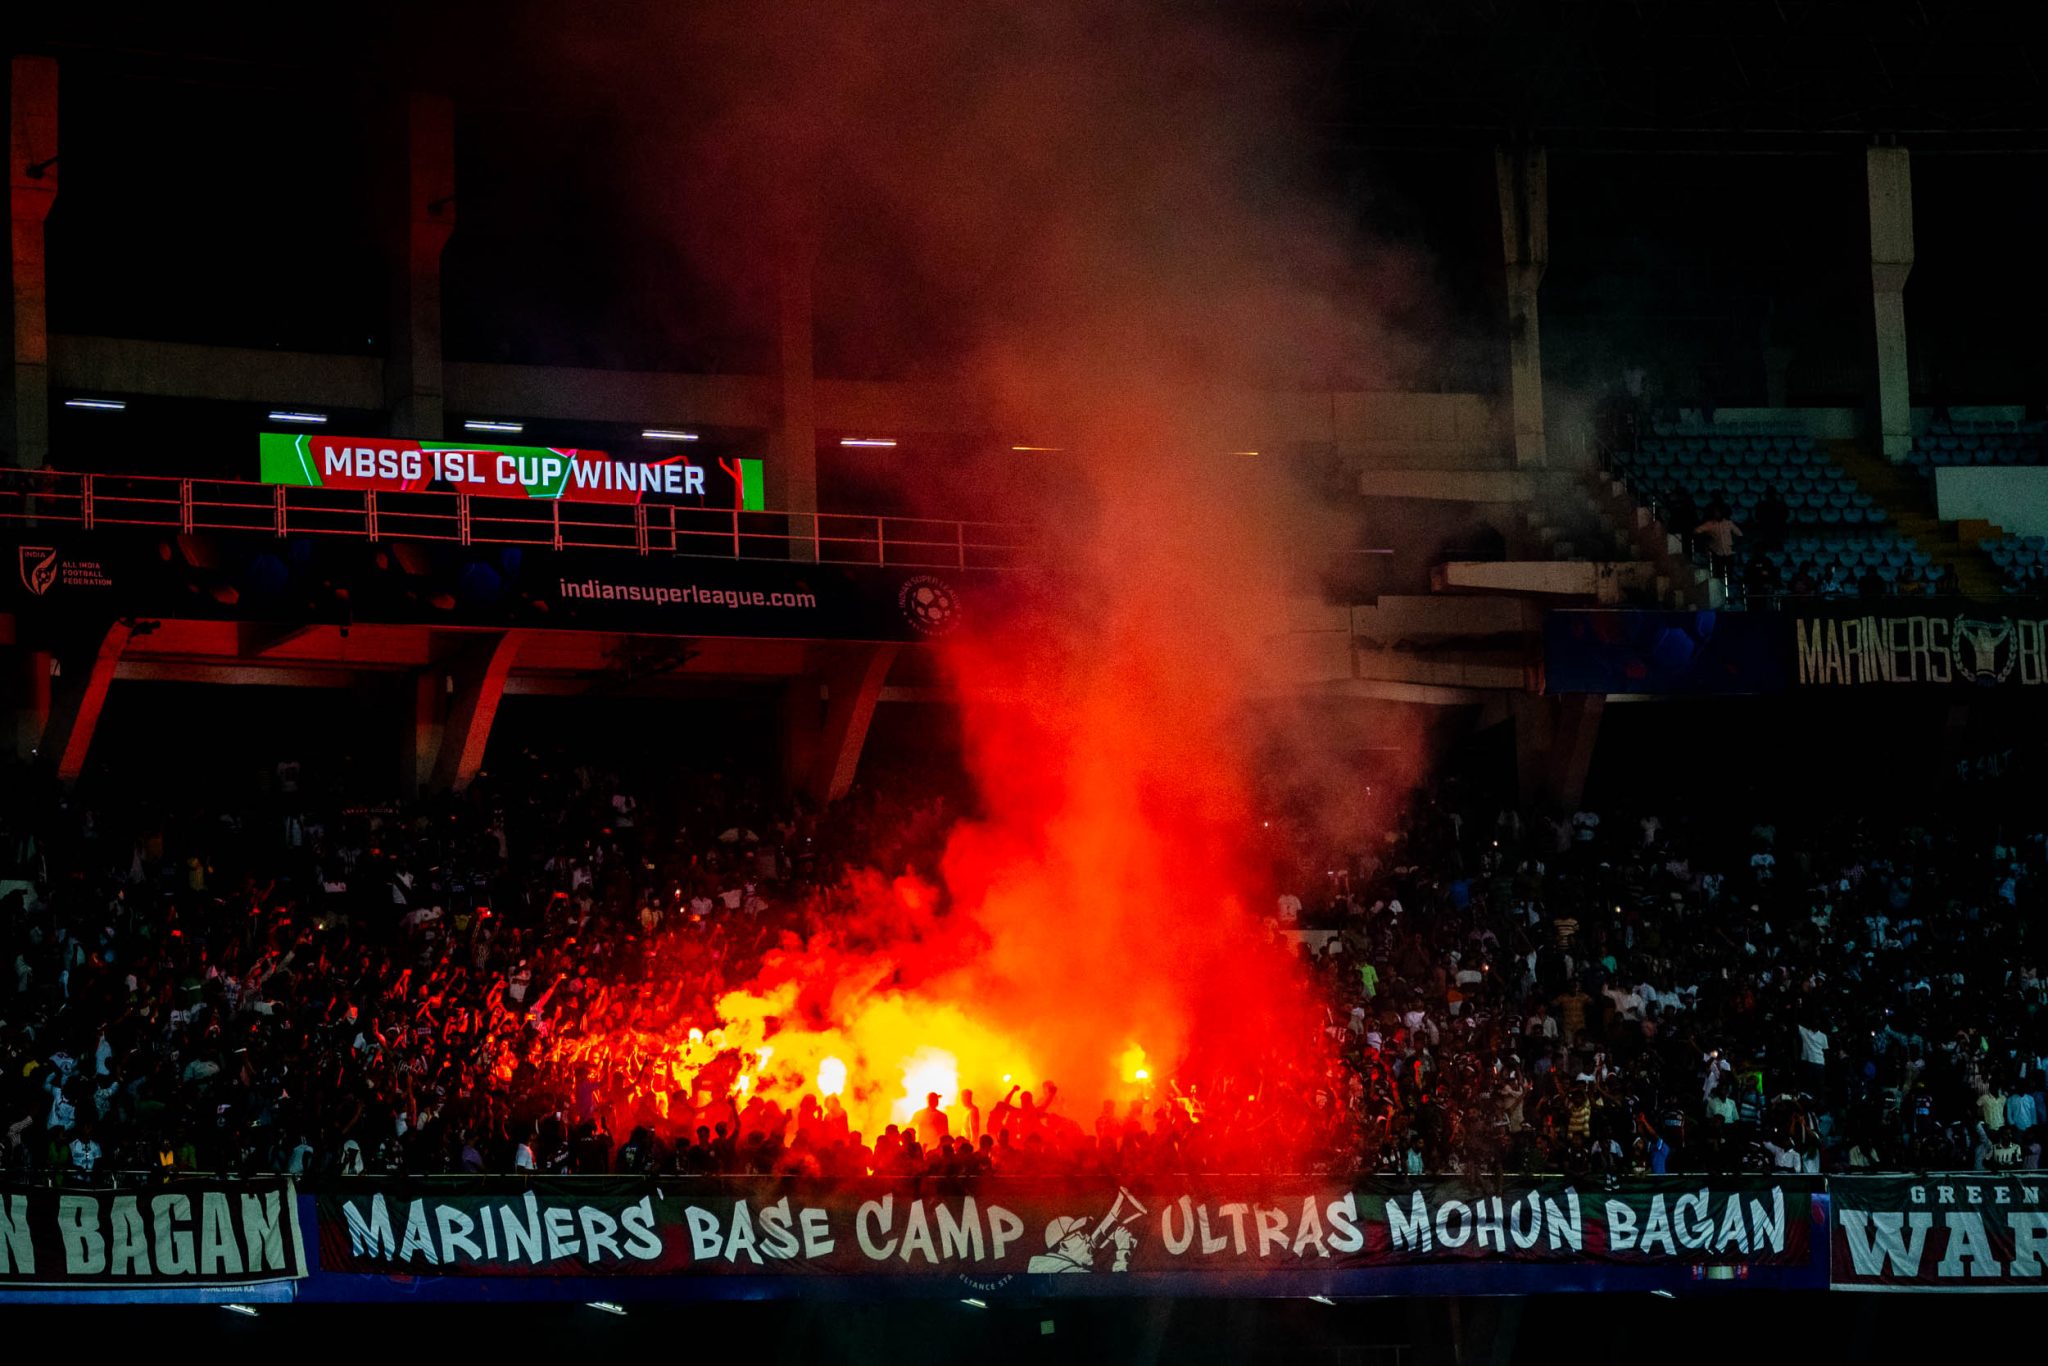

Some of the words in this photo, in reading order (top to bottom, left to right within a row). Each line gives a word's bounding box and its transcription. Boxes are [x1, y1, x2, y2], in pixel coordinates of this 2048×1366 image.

[325, 446, 422, 480] MBSG
[434, 452, 486, 482] ISL
[496, 455, 562, 486] CUP
[571, 459, 705, 495] WINNER
[62, 561, 77, 569] ALL
[79, 561, 101, 569] INDIA
[63, 577, 113, 587] FEDERATION
[559, 577, 817, 609] indiansuperleague.com
[1796, 615, 1952, 686] MARINERS
[1910, 1185, 2040, 1204] GREEN
[58, 1191, 286, 1275] BAGAN
[684, 1196, 835, 1265] BASE
[856, 1192, 1024, 1264] CAMP
[1161, 1191, 1364, 1258] ULTRAS
[1385, 1185, 1582, 1253] MOHUN
[1605, 1185, 1784, 1255] BAGAN
